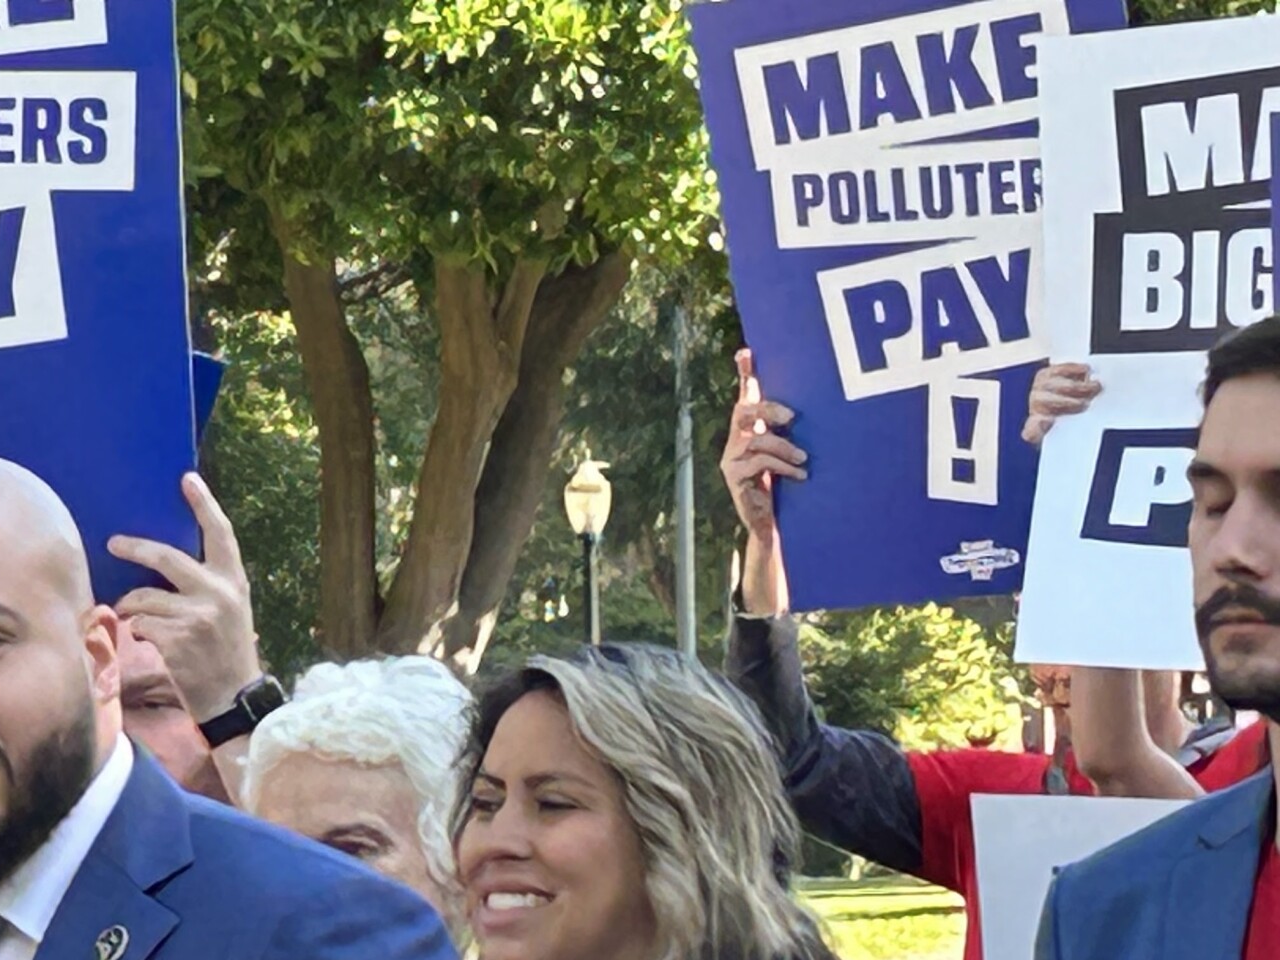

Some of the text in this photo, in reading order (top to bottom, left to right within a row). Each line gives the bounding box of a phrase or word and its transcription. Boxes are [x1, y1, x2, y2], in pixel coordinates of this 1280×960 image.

[762, 12, 1043, 146] MAKE
[792, 159, 1043, 227] POLLUTER
[843, 249, 1031, 374] PAY
[1120, 227, 1275, 331] BIG
[950, 395, 980, 484] !
